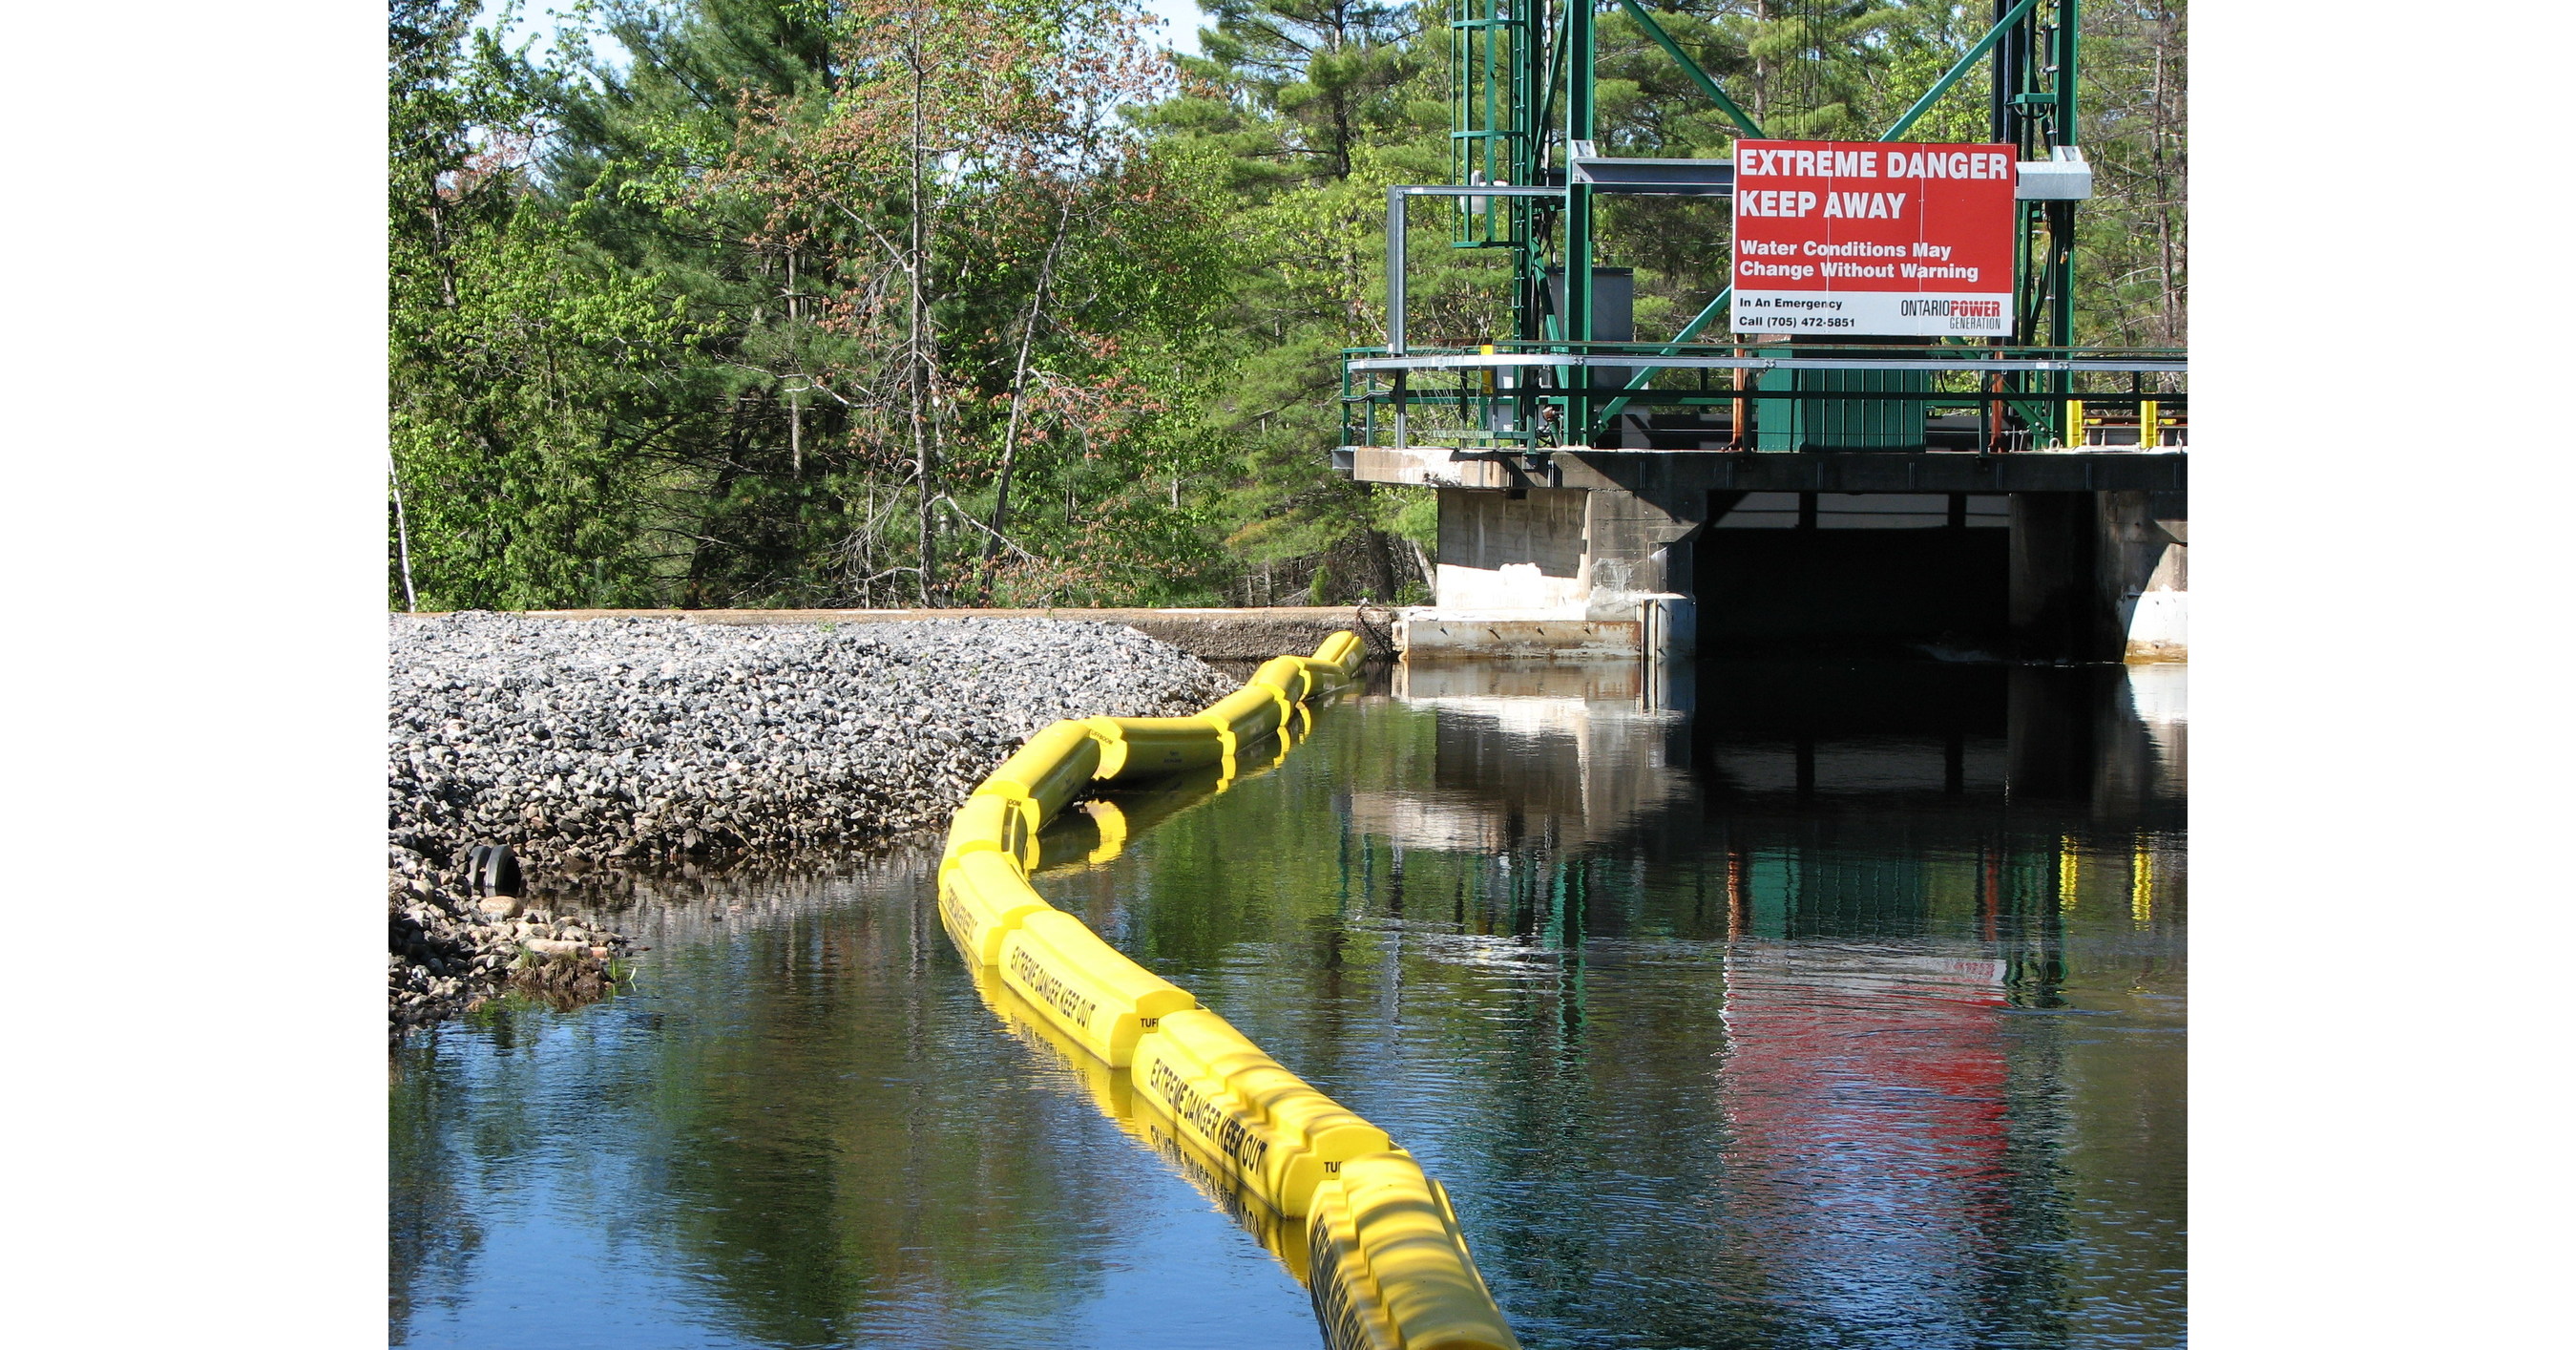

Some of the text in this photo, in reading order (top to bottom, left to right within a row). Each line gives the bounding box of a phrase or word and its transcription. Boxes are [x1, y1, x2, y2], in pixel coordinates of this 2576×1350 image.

[1740, 149, 2007, 179] EXTREME DANGER
[1739, 190, 1906, 219] KEEP AWAY
[1740, 240, 1952, 262] Water Conditions May
[1739, 261, 1979, 283] Change Without Warning
[1739, 298, 1842, 310] In An Emergency
[1739, 316, 1855, 328] Call (705) 472-5851
[1949, 317, 2000, 329] GENERATION
[1011, 945, 1096, 1030] EXTREME DANGER KEEP OUT
[1150, 1057, 1267, 1175] EXTREME DANGER KEEP OUT
